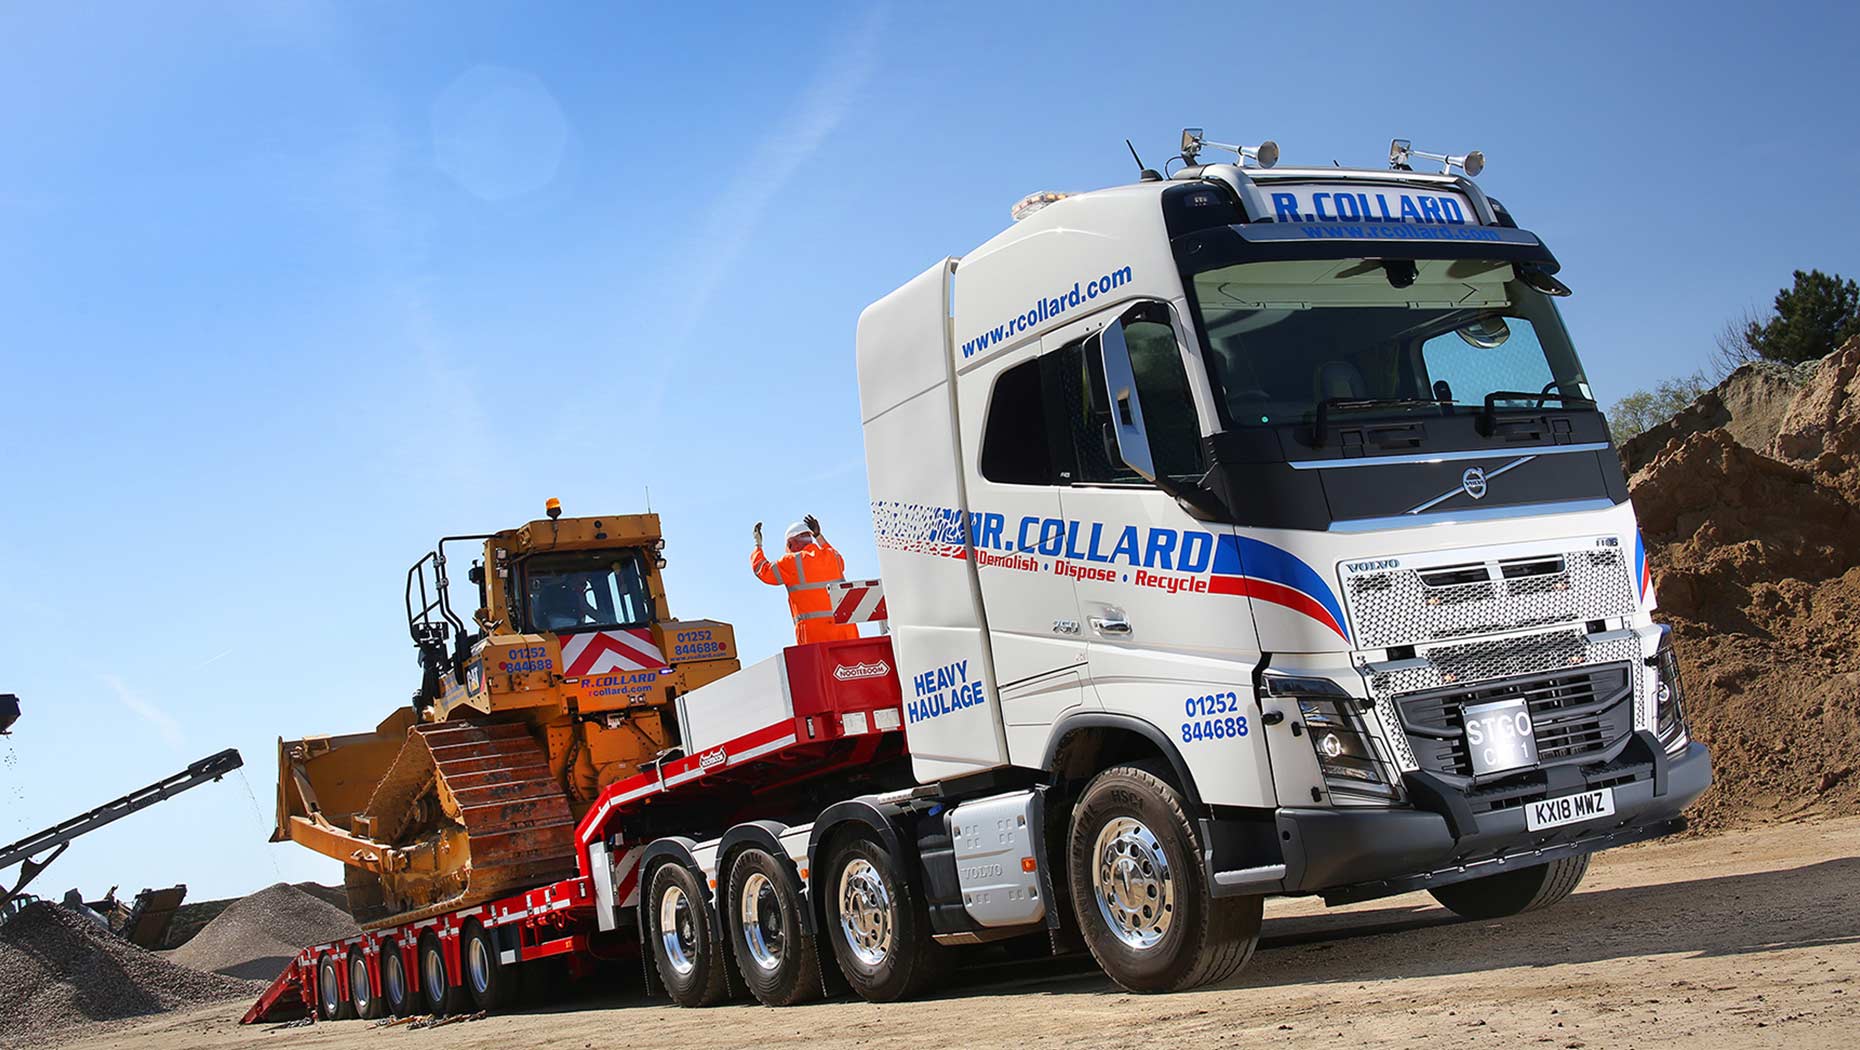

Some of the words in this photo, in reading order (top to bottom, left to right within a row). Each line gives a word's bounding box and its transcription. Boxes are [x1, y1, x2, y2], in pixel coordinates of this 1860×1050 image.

[1271, 192, 1466, 225] R.COLLARD
[1301, 222, 1500, 241] www.rcollard.com
[961, 265, 1133, 359] www.rcollard.com
[980, 512, 1214, 574] R.COLLARD
[978, 550, 1039, 572] Demolish
[1054, 559, 1117, 582] Dispose
[1134, 569, 1208, 594] Recycle
[1345, 559, 1400, 573] VOLVO
[674, 641, 719, 656] 844688
[677, 630, 713, 643] 01252
[505, 659, 553, 674] 844688
[508, 646, 546, 661] 01252
[580, 672, 657, 689] R.COLLARD
[588, 685, 653, 697] rcollard.com
[913, 659, 968, 698] HEAVY
[907, 680, 985, 724] HAULAGE
[1185, 691, 1238, 718] 01252
[1181, 715, 1249, 743] 844688
[1466, 711, 1533, 745] STGO
[1535, 798, 1572, 825] KX18
[1573, 791, 1605, 817] MWZ
[960, 864, 1003, 880] VOLVO
